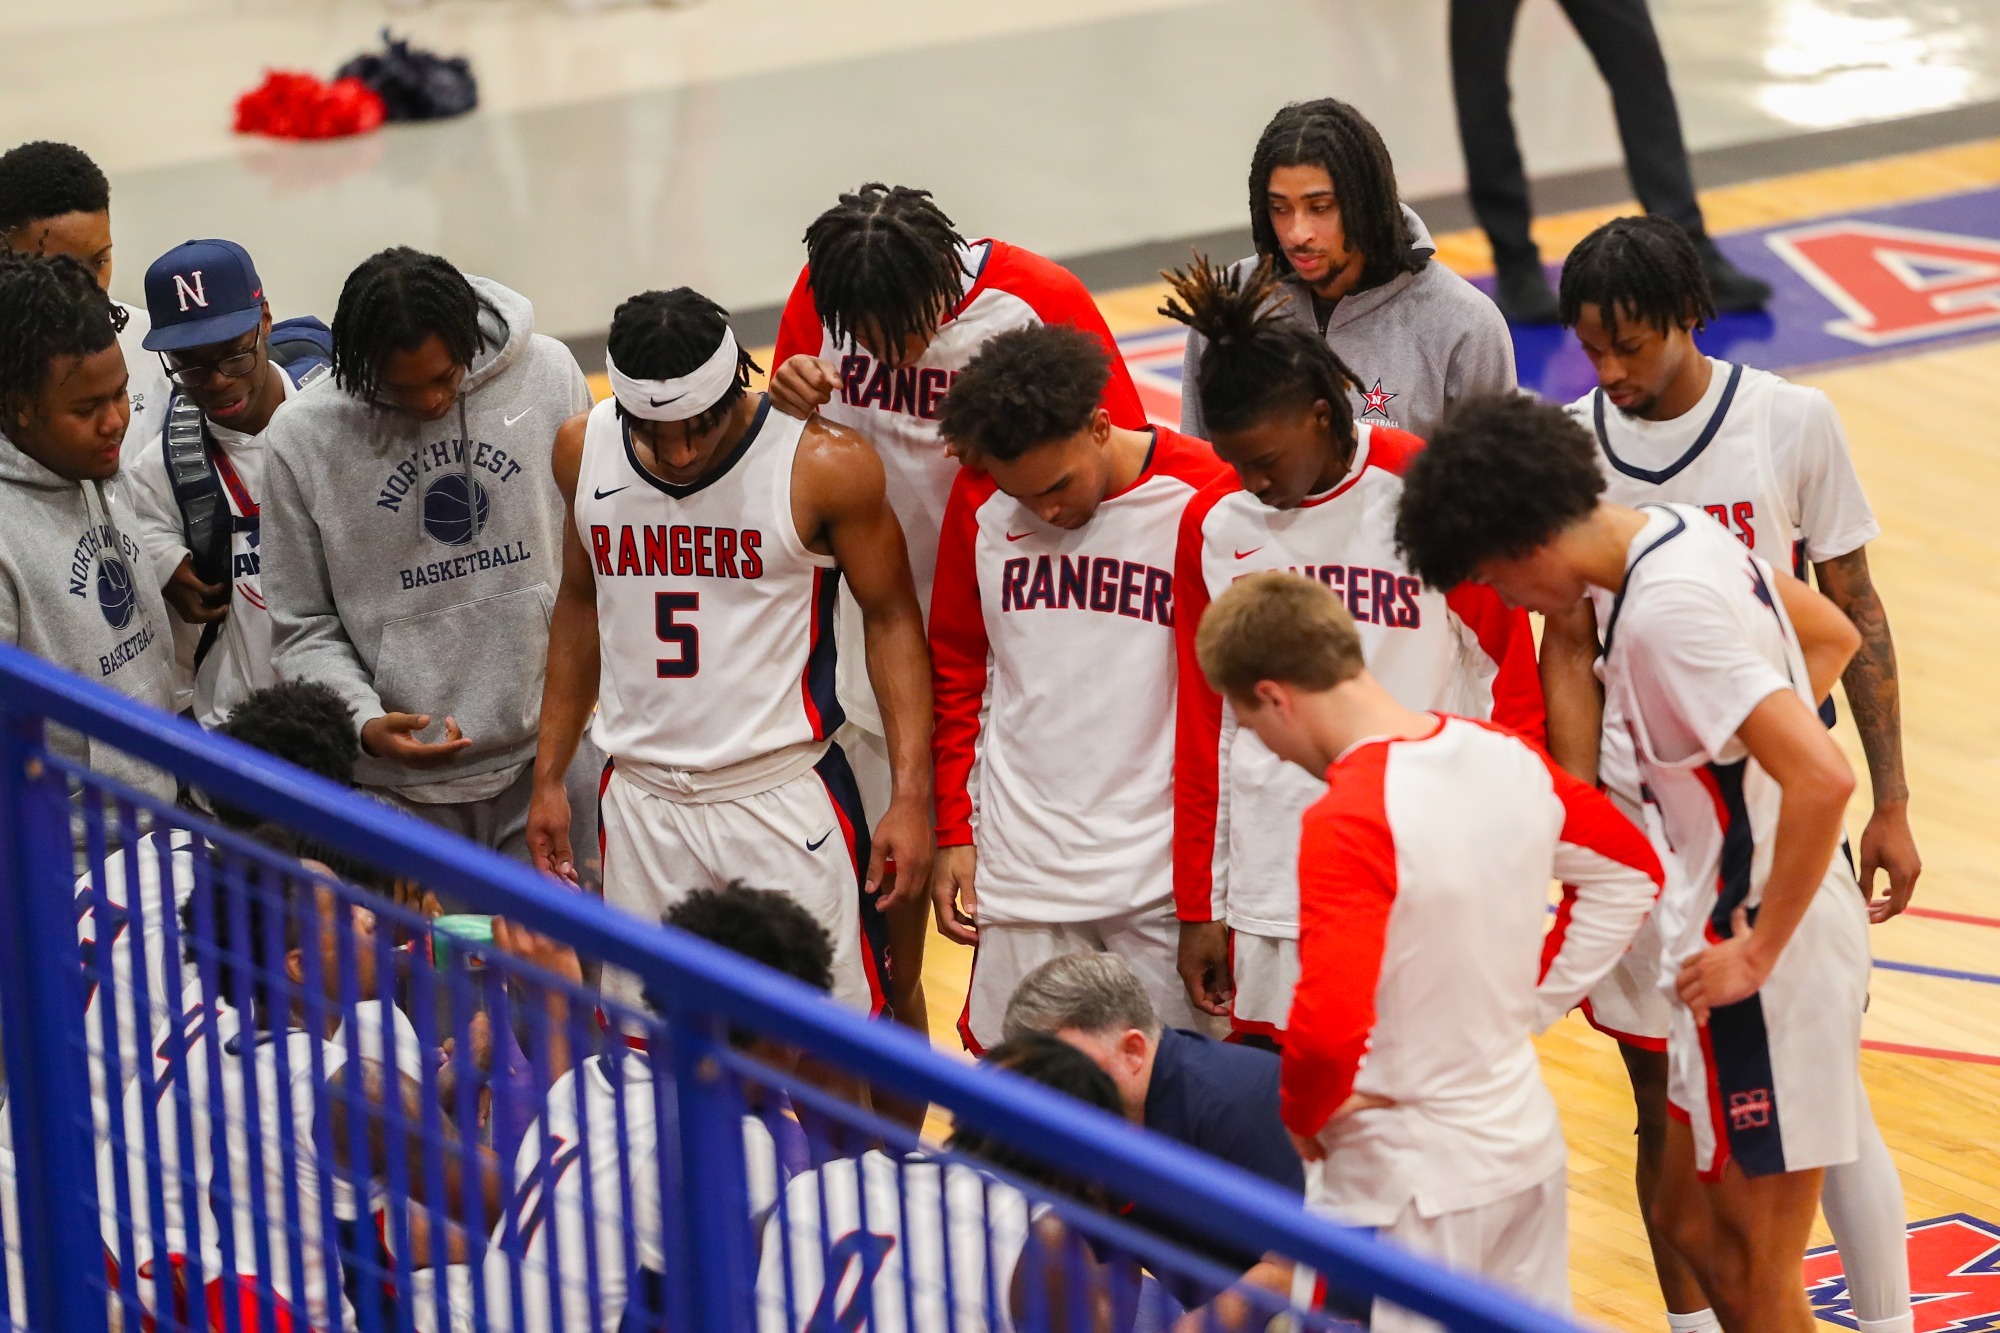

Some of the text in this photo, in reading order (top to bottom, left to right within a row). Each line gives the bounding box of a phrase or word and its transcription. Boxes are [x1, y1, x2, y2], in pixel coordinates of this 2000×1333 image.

[172, 270, 209, 312] N
[841, 354, 961, 420] RANG
[1371, 395, 1382, 405] N
[69, 525, 140, 598] NORTHWST
[400, 541, 531, 590] BASKETBALL
[590, 524, 763, 580] RANGERS
[1002, 554, 1176, 628] RANGER
[1231, 564, 1421, 630] GERS
[655, 592, 700, 679] 5
